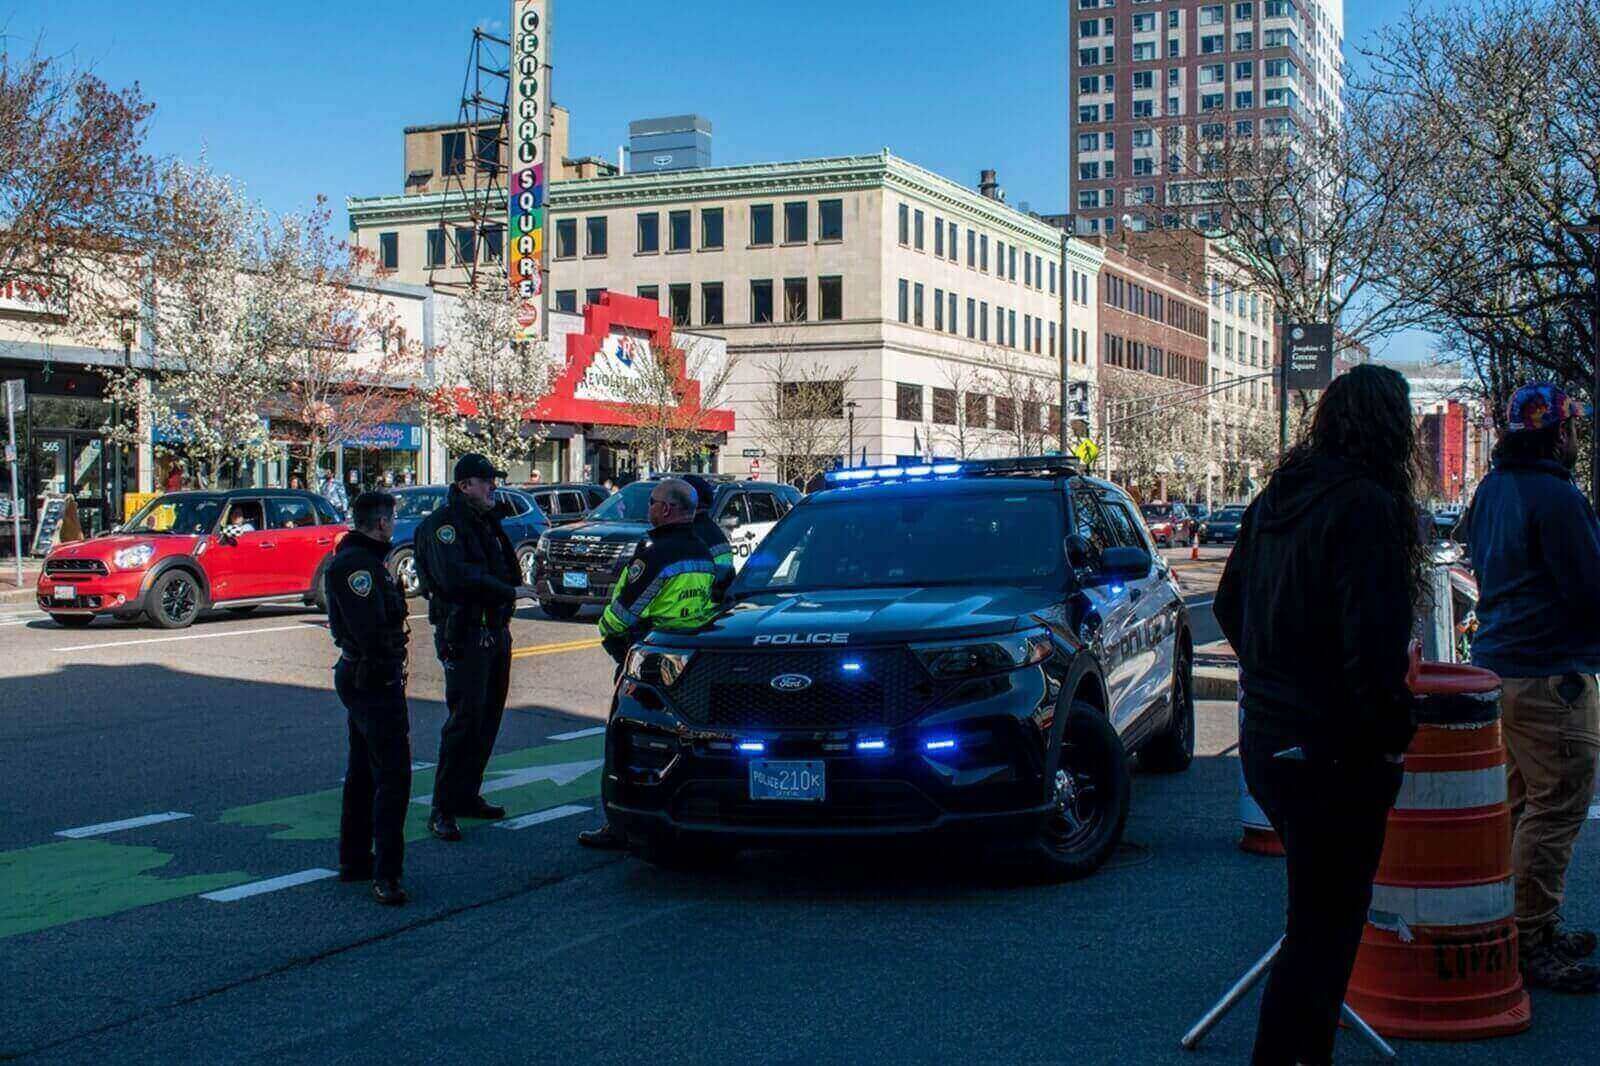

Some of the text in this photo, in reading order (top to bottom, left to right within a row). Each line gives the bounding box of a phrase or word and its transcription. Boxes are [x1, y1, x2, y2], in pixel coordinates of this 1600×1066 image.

[519, 11, 538, 163] CENTRAL
[517, 170, 536, 298] SQUARE
[1291, 362, 1317, 371] Square
[42, 442, 60, 452] 565
[753, 633, 850, 645] POLICE
